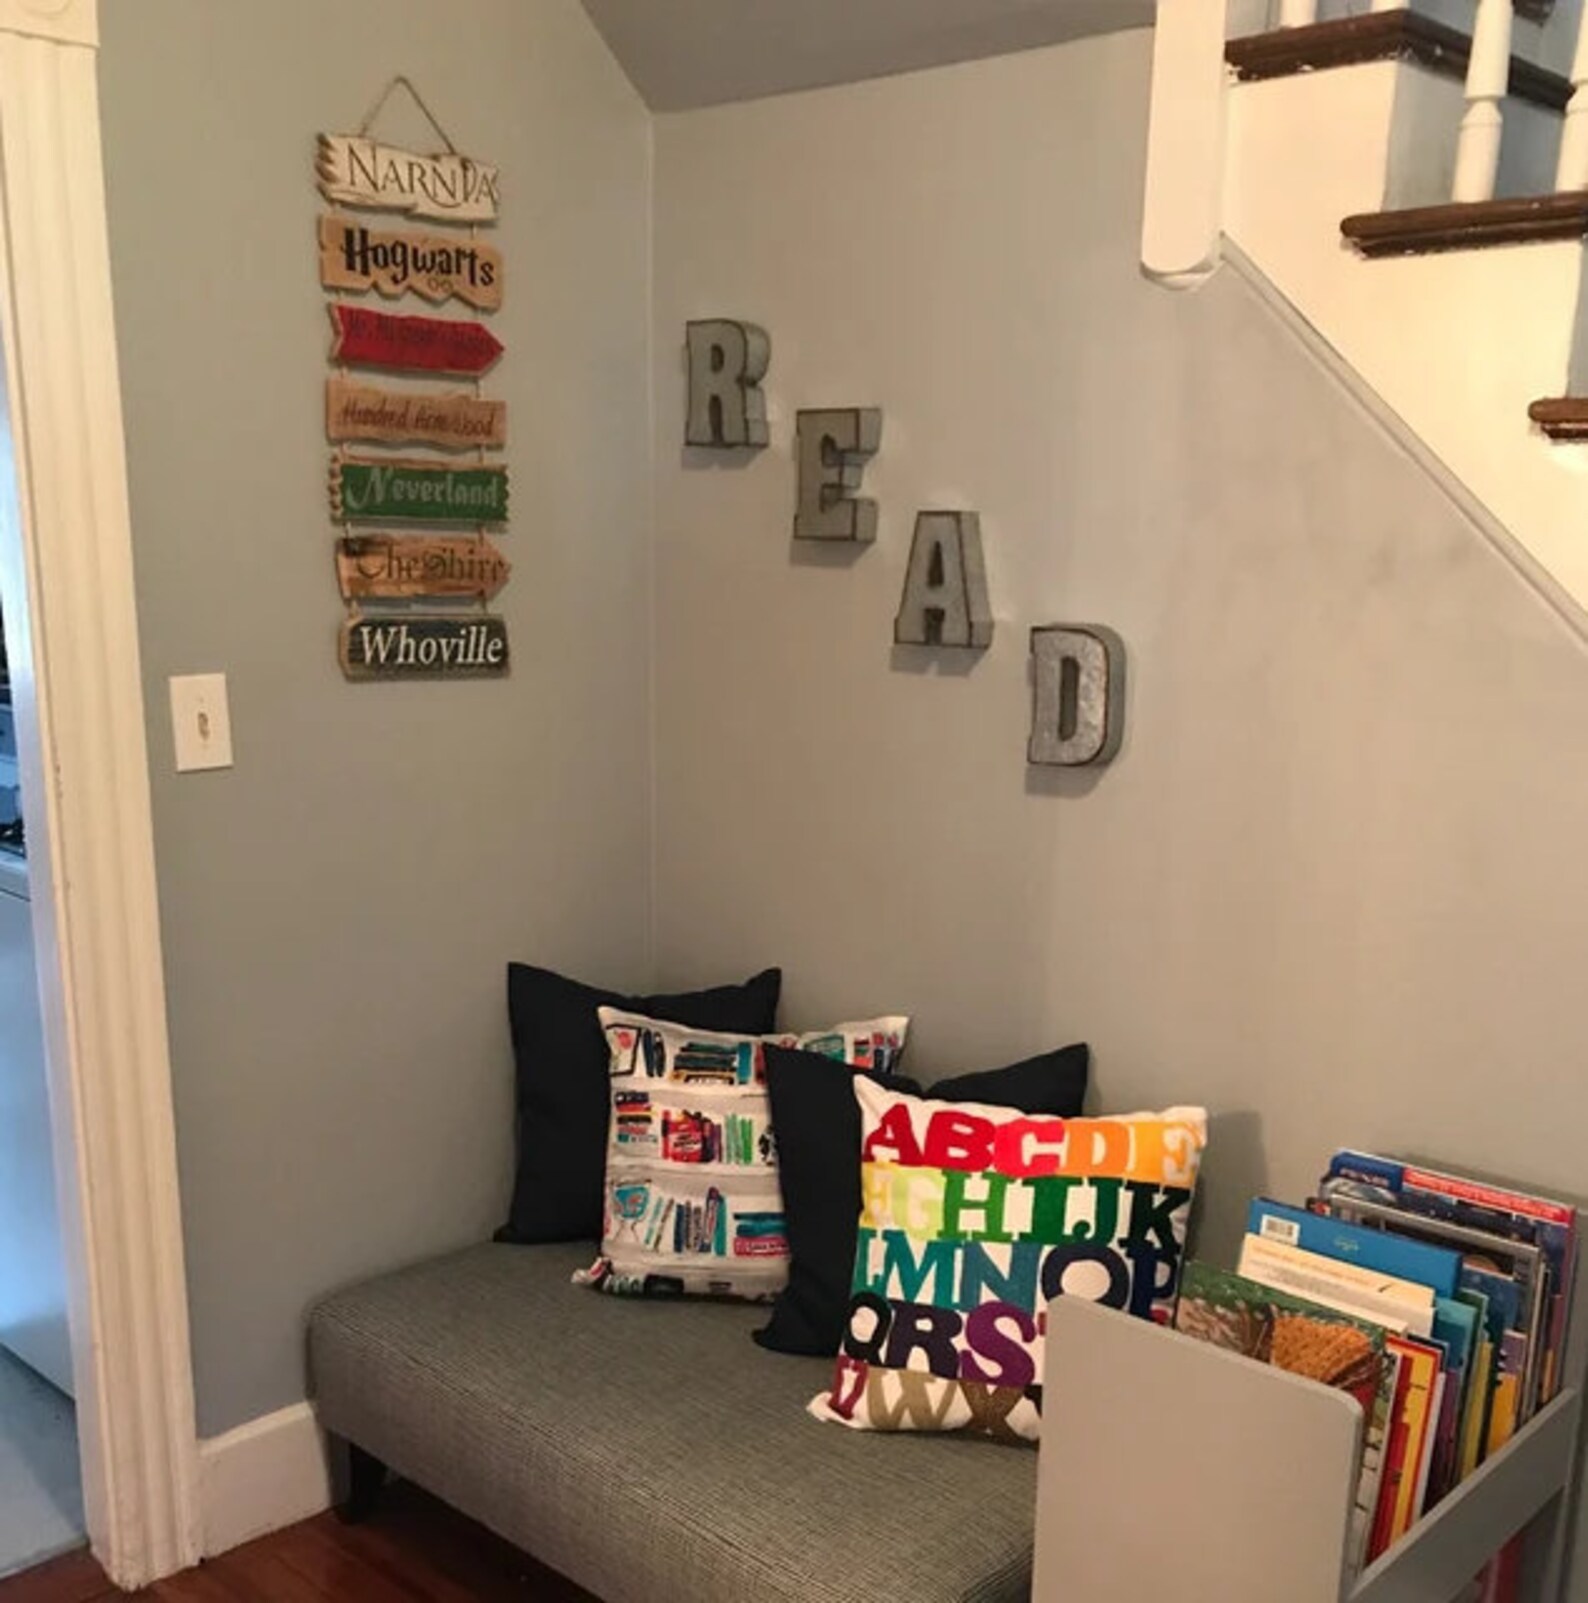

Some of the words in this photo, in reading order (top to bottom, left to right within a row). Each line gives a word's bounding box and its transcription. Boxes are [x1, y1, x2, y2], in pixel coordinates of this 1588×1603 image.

[342, 228, 494, 286] Hogwarts
[345, 466, 499, 507] Neverland
[360, 625, 503, 665] Whoville
